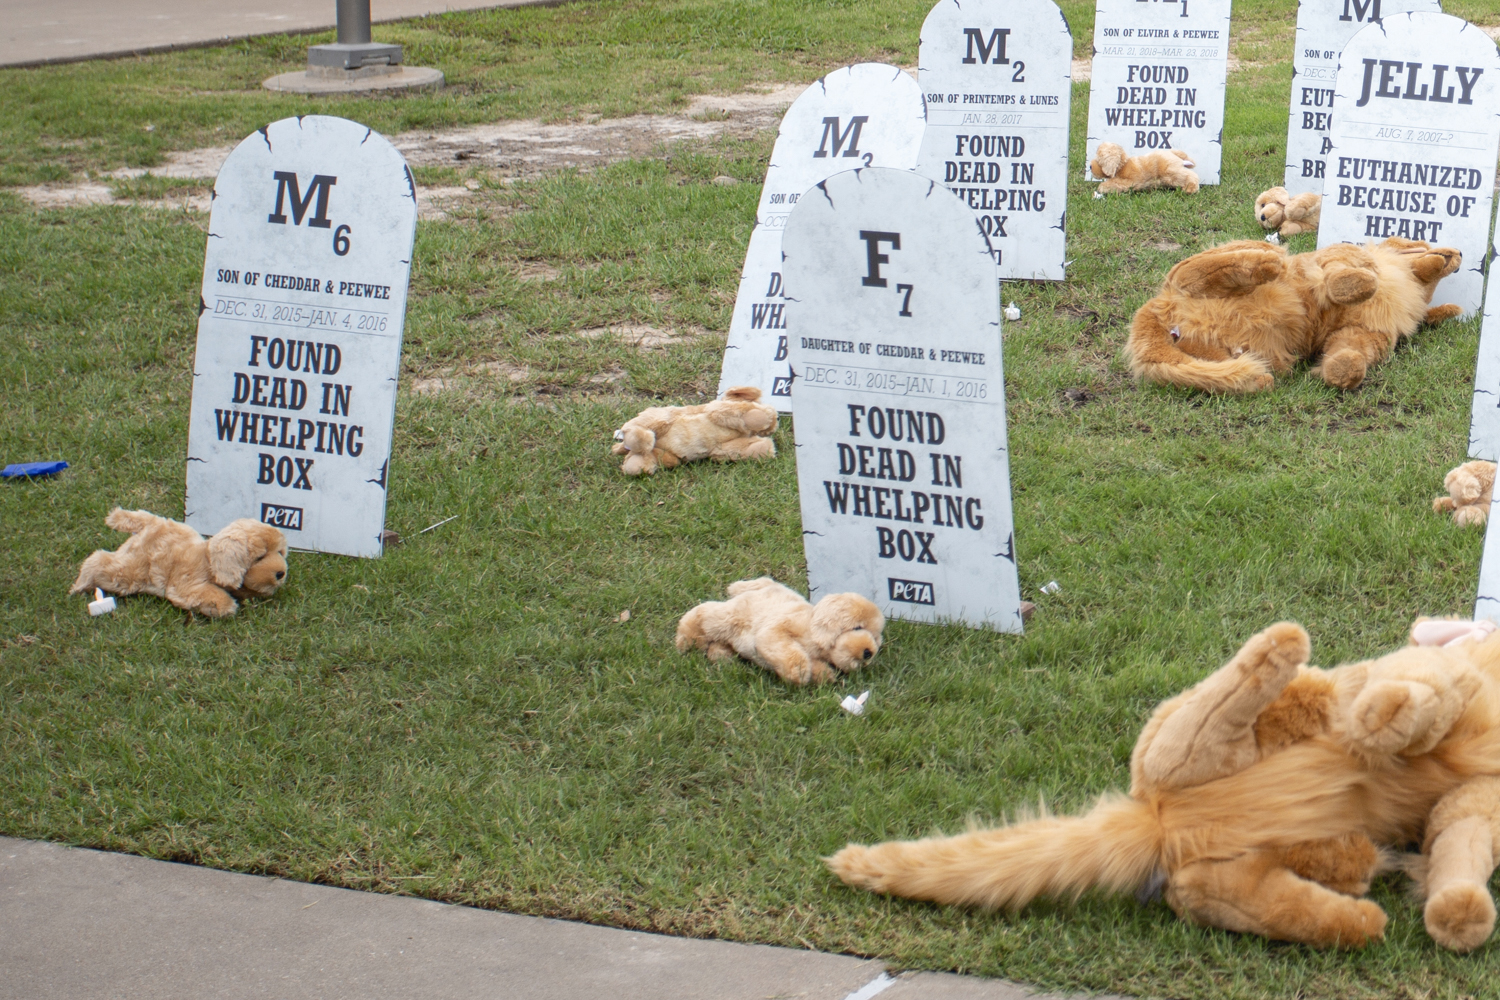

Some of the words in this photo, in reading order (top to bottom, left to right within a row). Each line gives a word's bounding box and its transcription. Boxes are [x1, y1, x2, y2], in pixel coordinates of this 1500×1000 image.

[1127, 65, 1189, 84] FOUND
[1356, 58, 1484, 107] JELLY
[927, 94, 943, 103] SON
[948, 94, 959, 103] OF
[963, 94, 1016, 105] PRINTEMPS
[1019, 96, 1026, 104] &
[1030, 96, 1058, 105] LUNES
[1117, 87, 1166, 105] DEAD
[1175, 88, 1197, 106] IN
[1105, 108, 1205, 128] WHELPING
[956, 135, 1025, 157] FOUND
[1134, 131, 1172, 149] BOX
[1376, 128, 1402, 139] AUG.
[1407, 130, 1414, 140] 7,
[945, 161, 1000, 183] DEAD
[1011, 163, 1034, 185] IN
[1337, 157, 1482, 190] EUTHANIZED
[950, 188, 1045, 212] HELPING
[1337, 185, 1436, 214] BECAUSE
[1447, 195, 1476, 218] OF
[1365, 216, 1442, 243] HEART
[217, 269, 239, 284] SON
[245, 272, 260, 285] OF
[265, 274, 320, 292] CHEDDAR
[326, 281, 334, 293] &
[339, 282, 390, 300] PEEWEE
[248, 335, 341, 375] FOUND
[801, 337, 854, 353] DAUGHTER
[859, 343, 871, 354] OF
[877, 345, 924, 359] CHEDDAR
[929, 349, 936, 360] &
[941, 350, 985, 365] PEEWEE
[232, 373, 307, 410] DEAD
[320, 383, 352, 416] IN
[215, 409, 363, 457] WHELPING
[848, 404, 945, 445] FOUND
[257, 453, 314, 490] BOX
[837, 443, 915, 482] DEAD
[929, 453, 962, 488] IN
[824, 481, 983, 530] WHELPING
[876, 526, 937, 564] BOX
